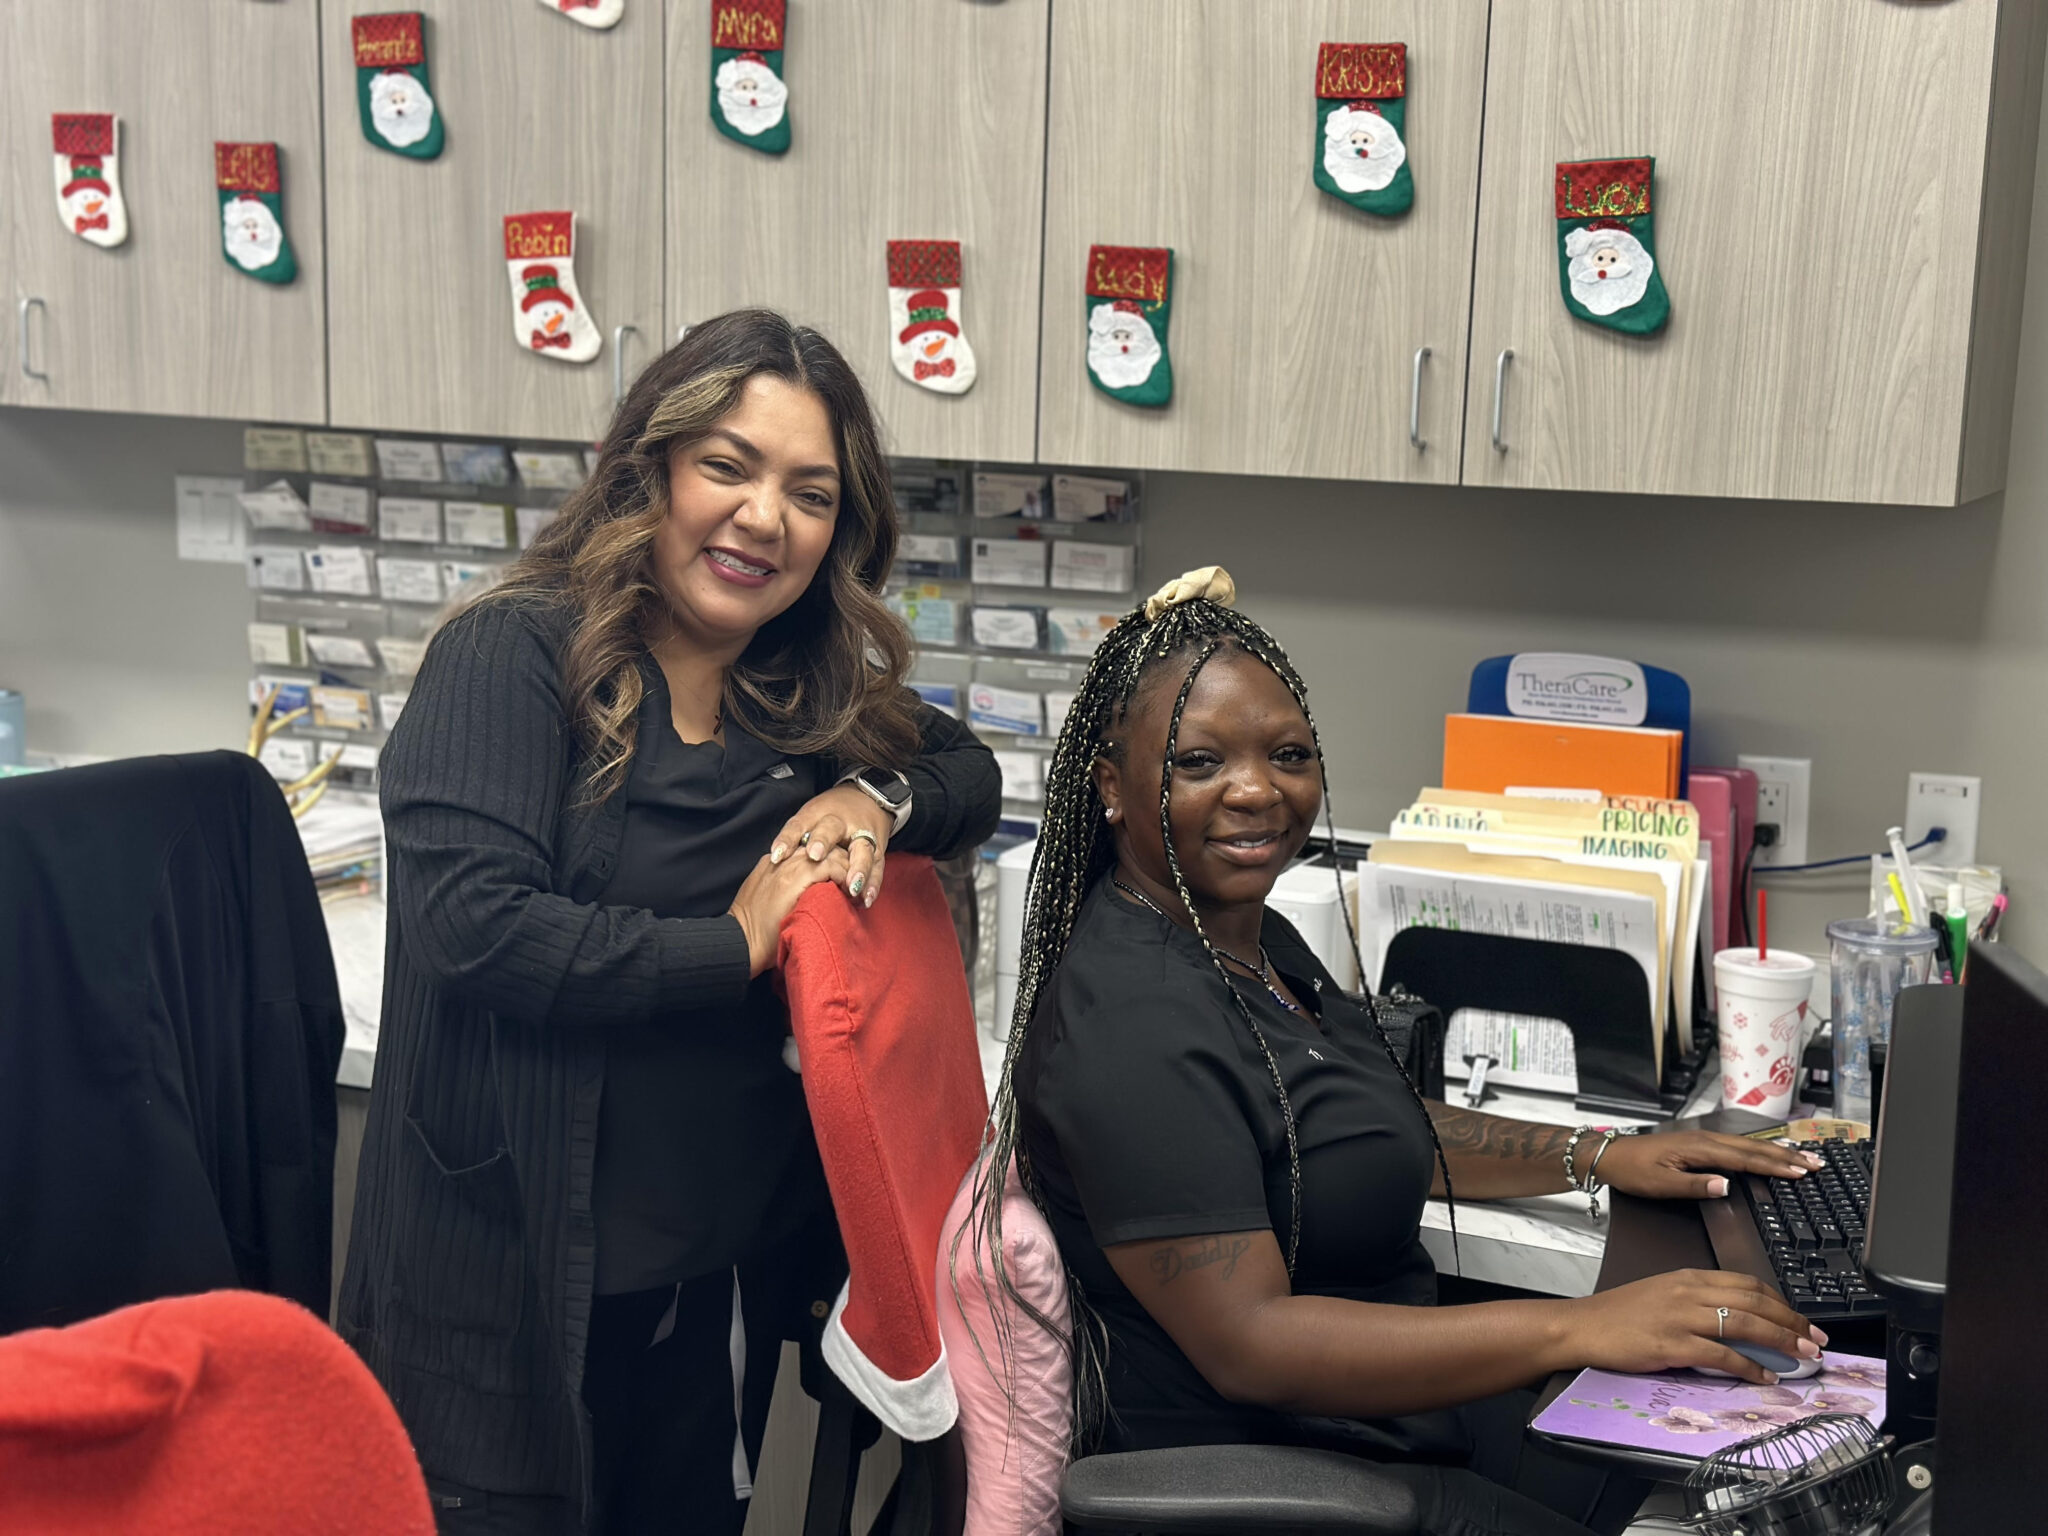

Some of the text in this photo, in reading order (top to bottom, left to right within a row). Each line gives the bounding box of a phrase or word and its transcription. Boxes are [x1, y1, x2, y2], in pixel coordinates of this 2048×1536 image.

[715, 7, 778, 44] Myra
[1321, 48, 1403, 95] KRISTA
[507, 221, 568, 257] Robin
[1516, 673, 1618, 699] TheraCare
[1602, 809, 1690, 837] PRICING
[1583, 835, 1667, 860] IMAGING
